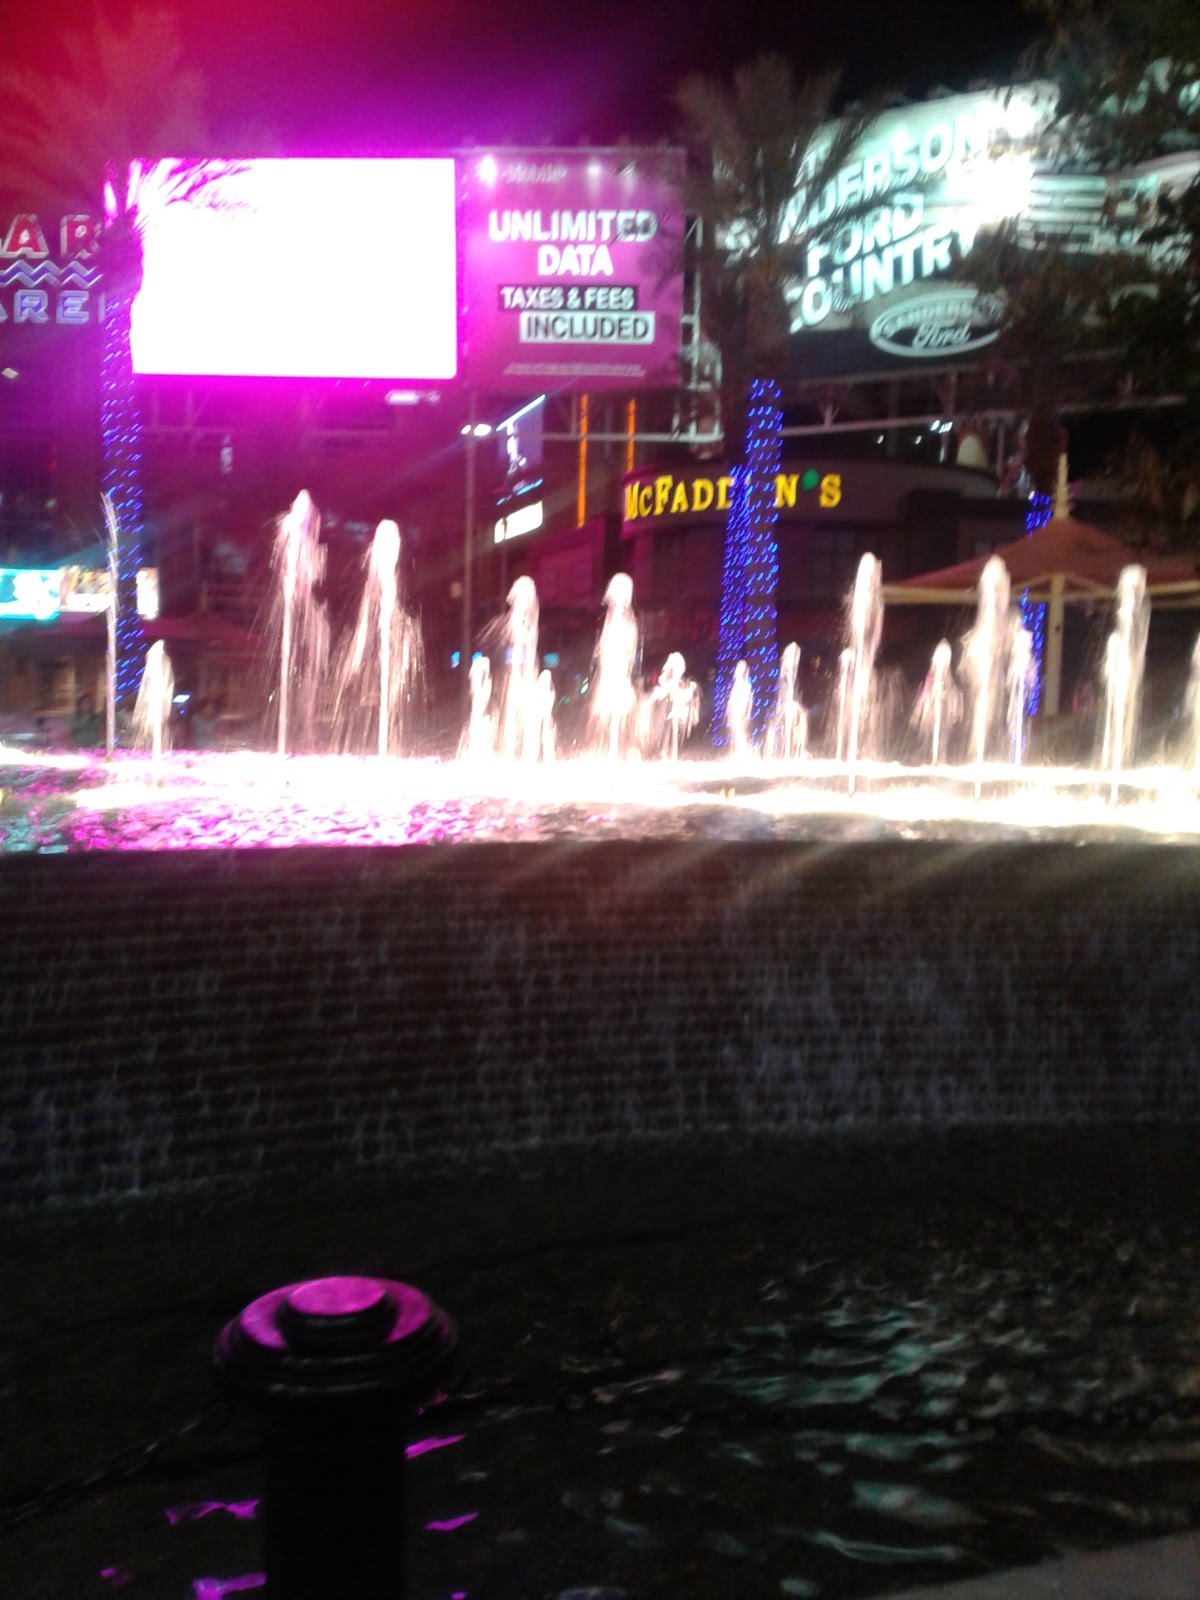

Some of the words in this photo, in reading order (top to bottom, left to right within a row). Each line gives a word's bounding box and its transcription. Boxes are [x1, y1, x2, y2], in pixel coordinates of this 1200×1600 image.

[488, 210, 658, 242] UNLIMITED
[538, 245, 613, 276] DATA
[500, 286, 564, 309] TAXES
[567, 286, 581, 309] &
[585, 286, 635, 310] FEES
[526, 316, 649, 340] INCLUDED
